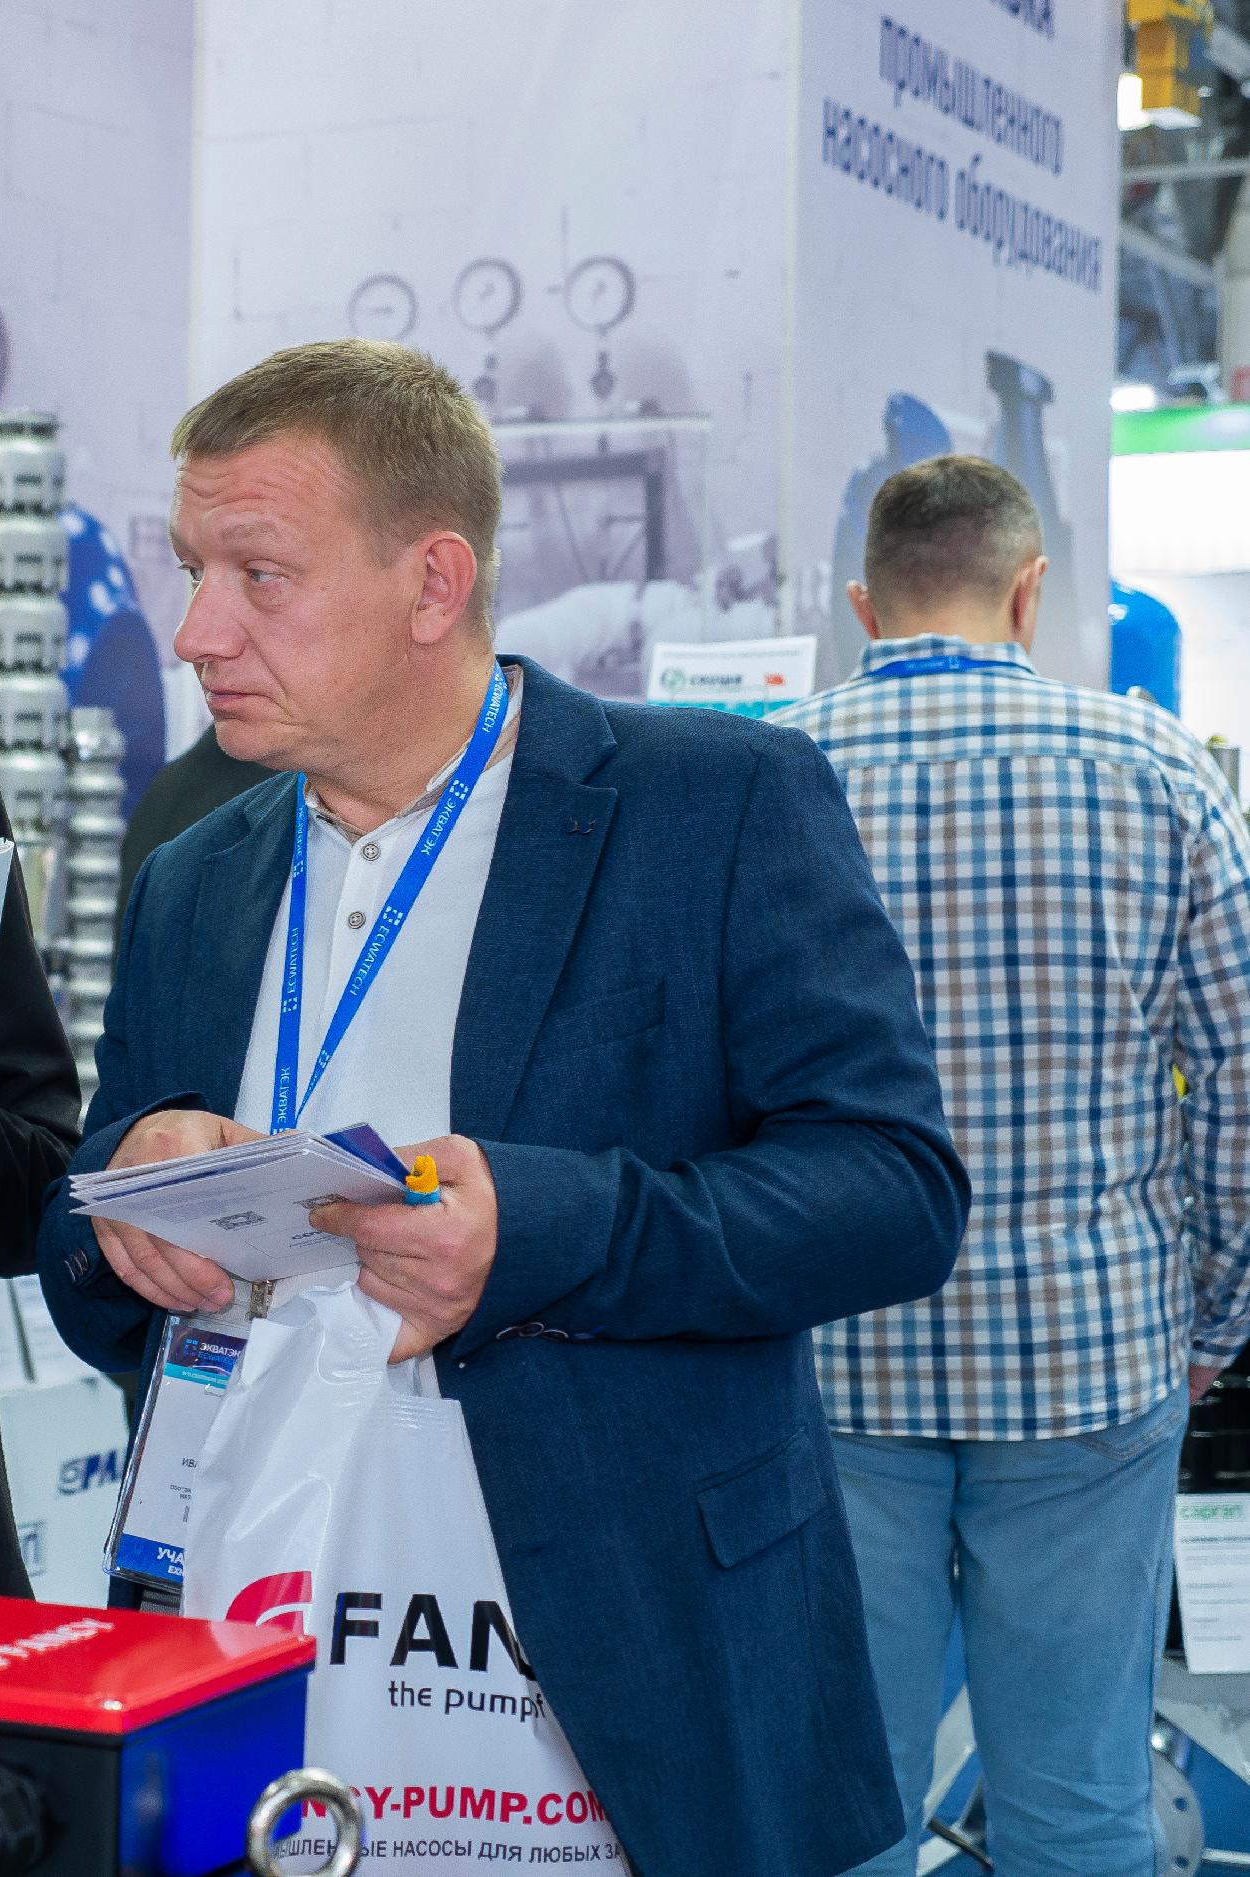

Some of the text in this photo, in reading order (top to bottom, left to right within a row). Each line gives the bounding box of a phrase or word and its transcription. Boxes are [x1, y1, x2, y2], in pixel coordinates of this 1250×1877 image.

[879, 15, 1063, 177] промышленного
[822, 97, 1101, 292] насосного оборудования
[350, 925, 390, 997] ECWATECH
[278, 1066, 291, 1124] ЭКВАТЭК
[329, 1592, 538, 1682] FAN
[388, 1681, 432, 1707] the
[393, 1839, 473, 1858] НАСОСЫ
[478, 1842, 522, 1862] ДЛЯ
[529, 1844, 601, 1863] ЛЮБЫХ
